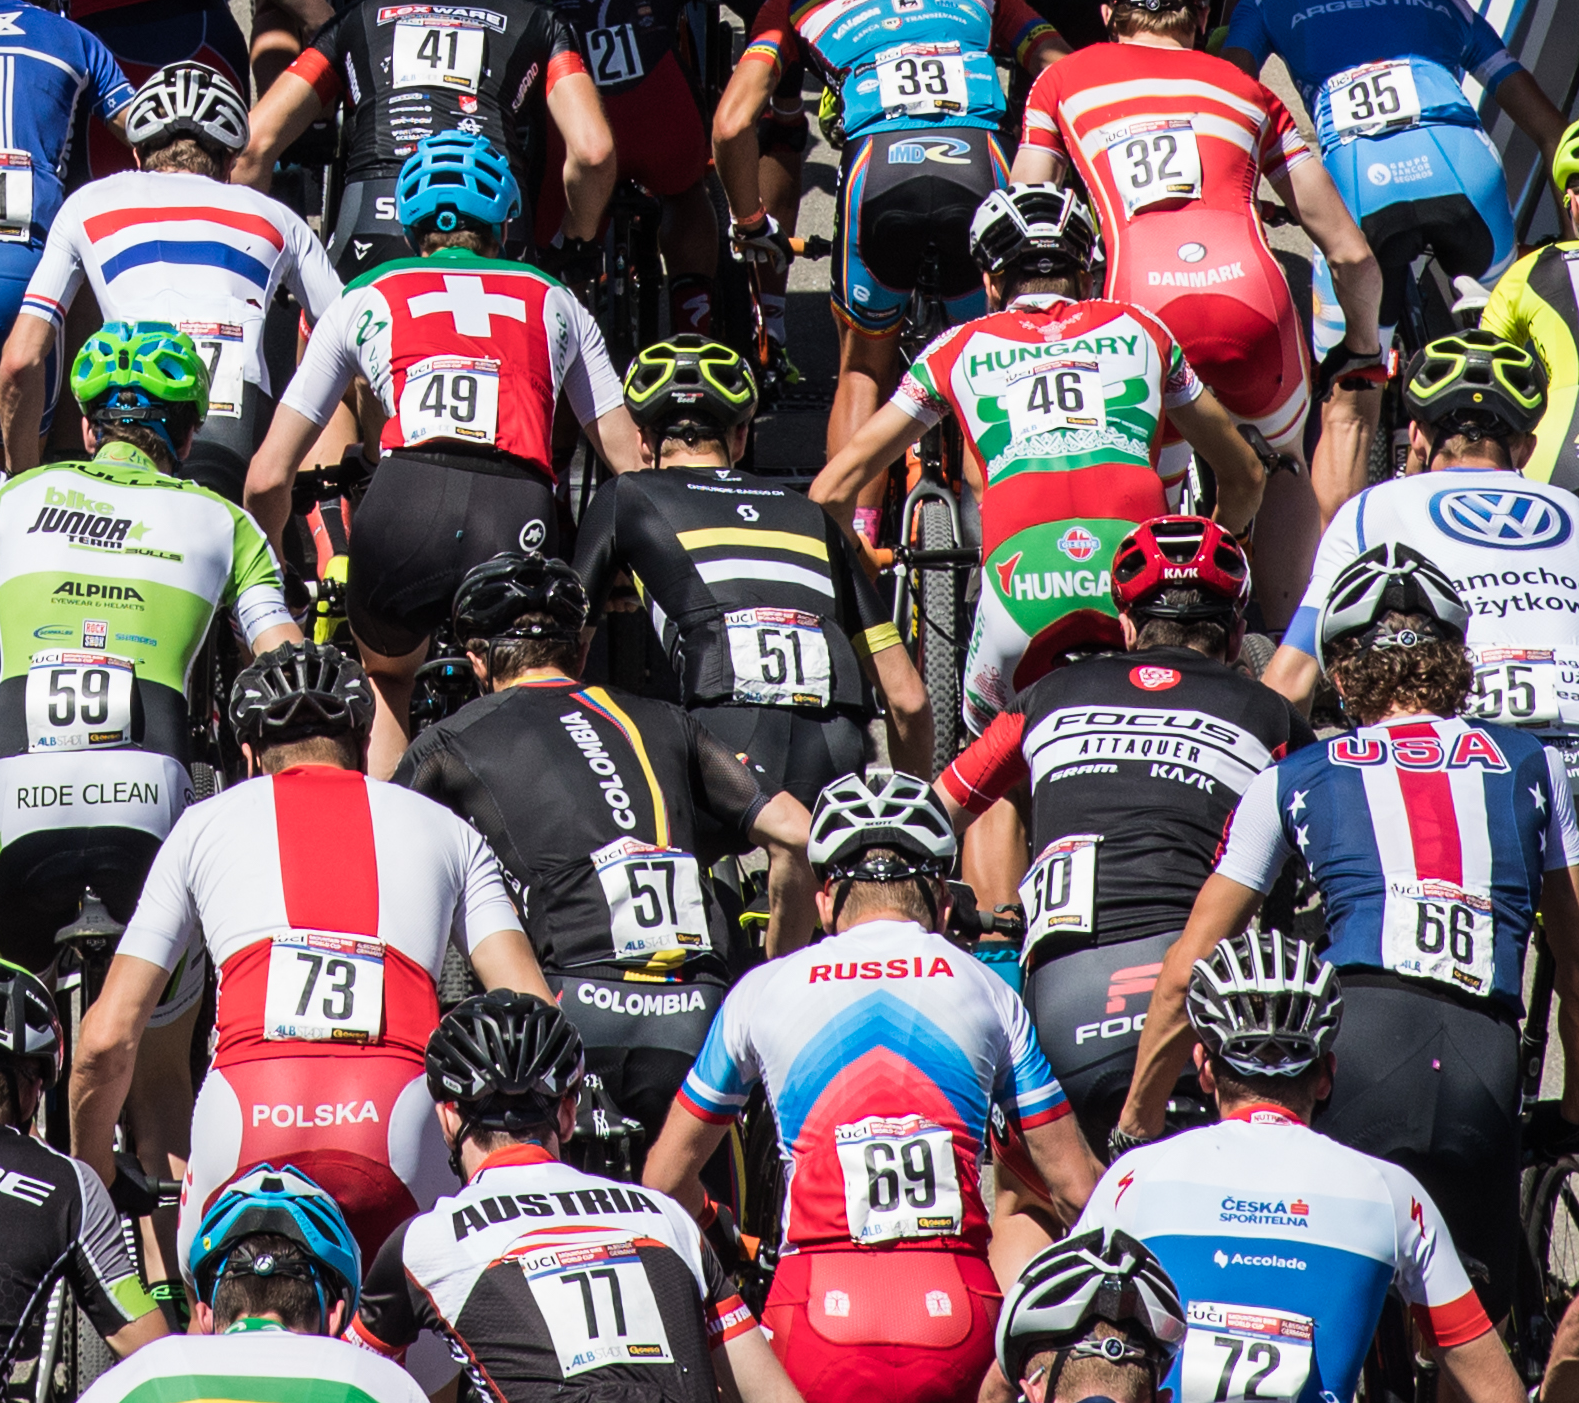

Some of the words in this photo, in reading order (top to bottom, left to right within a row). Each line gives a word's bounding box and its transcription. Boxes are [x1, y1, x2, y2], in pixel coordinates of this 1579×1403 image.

[417, 28, 459, 69] 41
[894, 58, 947, 97] 33
[1125, 135, 1183, 186] 32
[1148, 262, 1245, 288] DANMARK
[970, 335, 1139, 377] HUNGARY
[418, 374, 475, 422] 49
[1027, 373, 1085, 415] 46
[44, 486, 114, 515] bike
[27, 507, 132, 541] JUNIOR
[53, 581, 145, 602] ALPINA
[759, 630, 805, 686] 51
[48, 669, 109, 727] 59
[1052, 710, 1240, 747] FOCUS
[1079, 738, 1200, 764] ATTAQUER
[1328, 730, 1511, 772] USA
[16, 787, 73, 808] RIDE
[82, 782, 159, 806] CLEAN
[626, 860, 677, 925] 57
[1415, 902, 1475, 965] 66
[296, 952, 356, 1020] 73
[808, 956, 955, 984] RUSSIA
[577, 982, 706, 1016] COLOMBIA
[251, 1100, 379, 1127] POLSKA
[865, 1139, 934, 1212] 69
[450, 1189, 663, 1241] AUSTRIA
[1219, 1209, 1309, 1229] SPOŘITELNA
[1221, 1195, 1287, 1216] ČESKÁ
[1232, 1254, 1307, 1271] Accolade
[561, 1267, 626, 1339] 77
